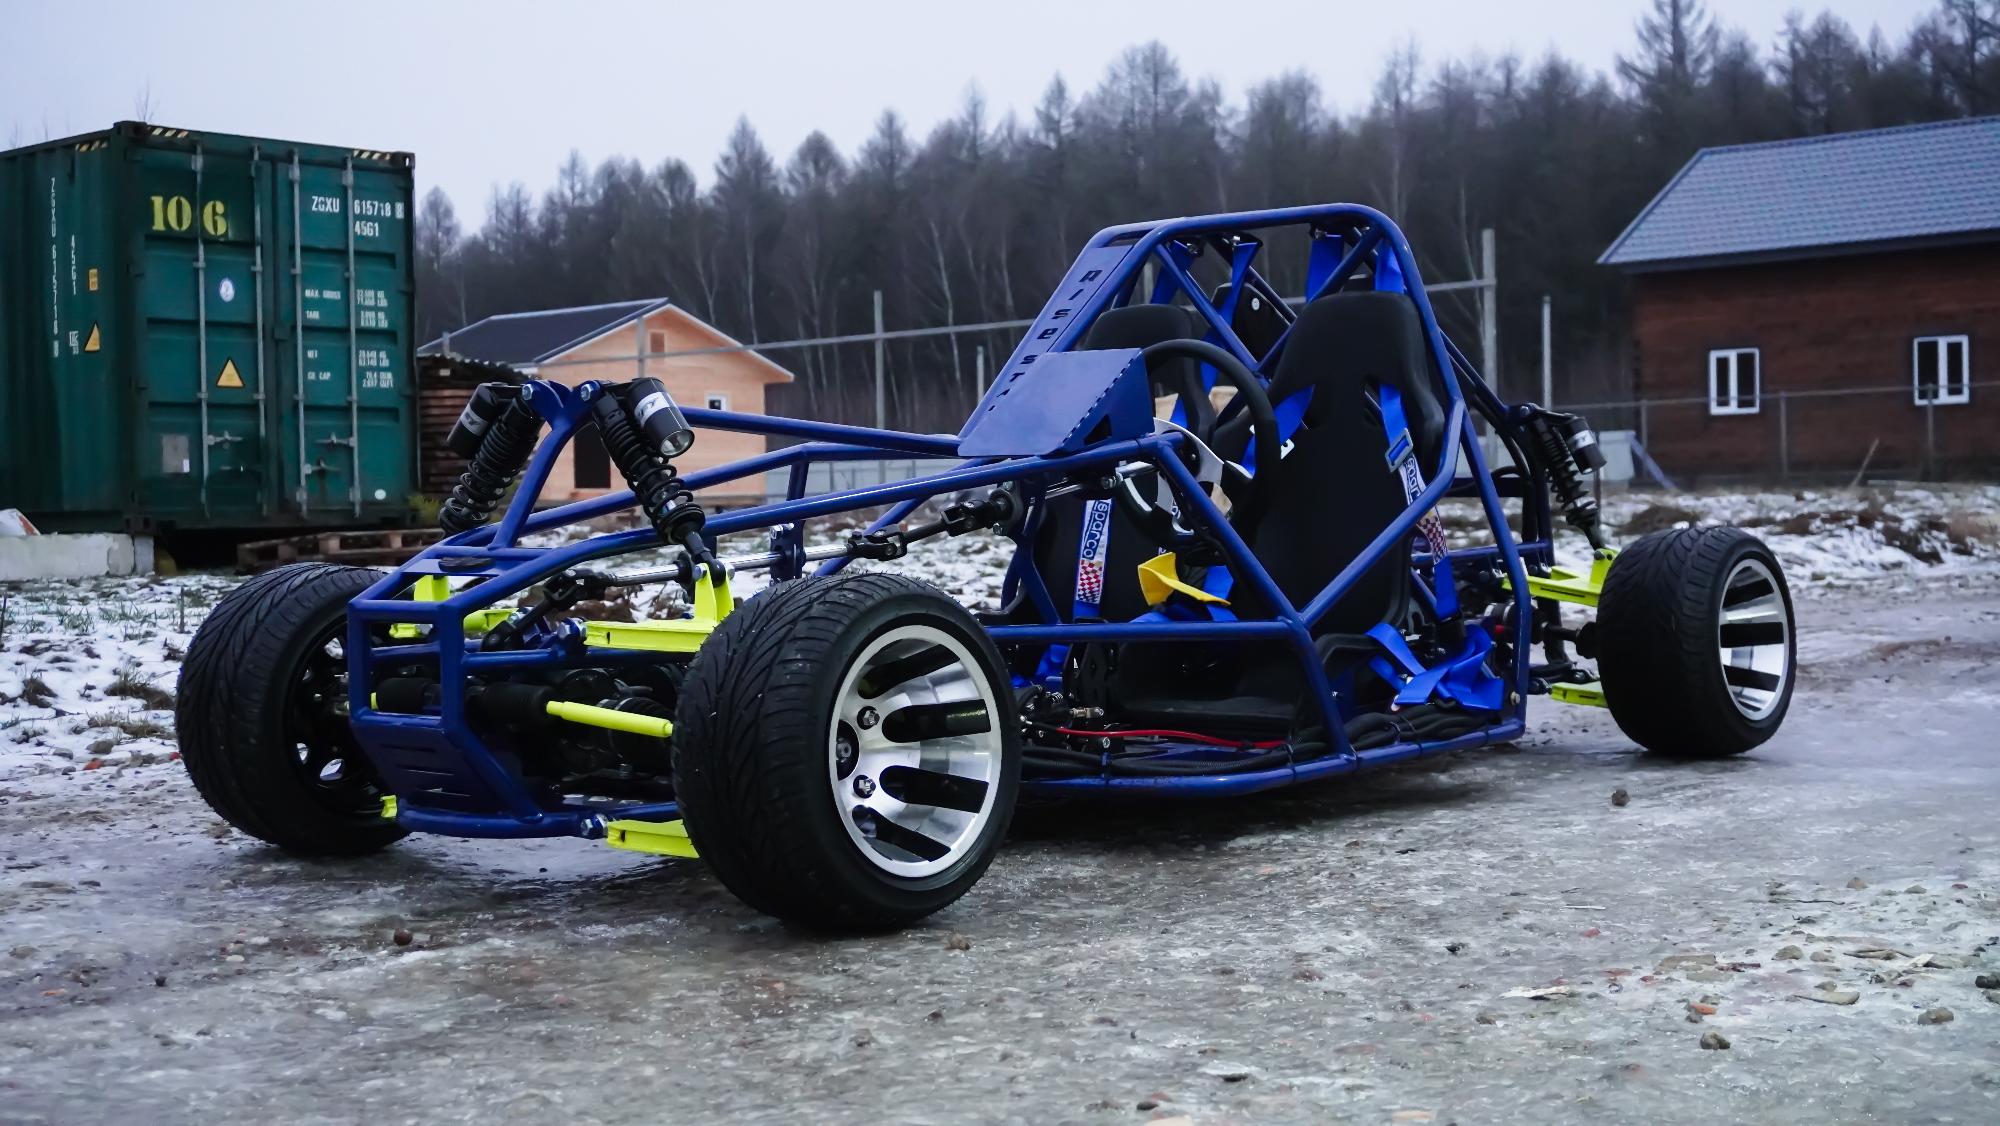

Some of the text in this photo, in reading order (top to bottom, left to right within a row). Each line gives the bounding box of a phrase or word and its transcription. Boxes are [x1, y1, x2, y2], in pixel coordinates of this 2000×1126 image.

[354, 199, 391, 217] 615718
[354, 220, 379, 237] 45G1
[1406, 457, 1421, 498] spar
[1083, 502, 1108, 558] sparco
